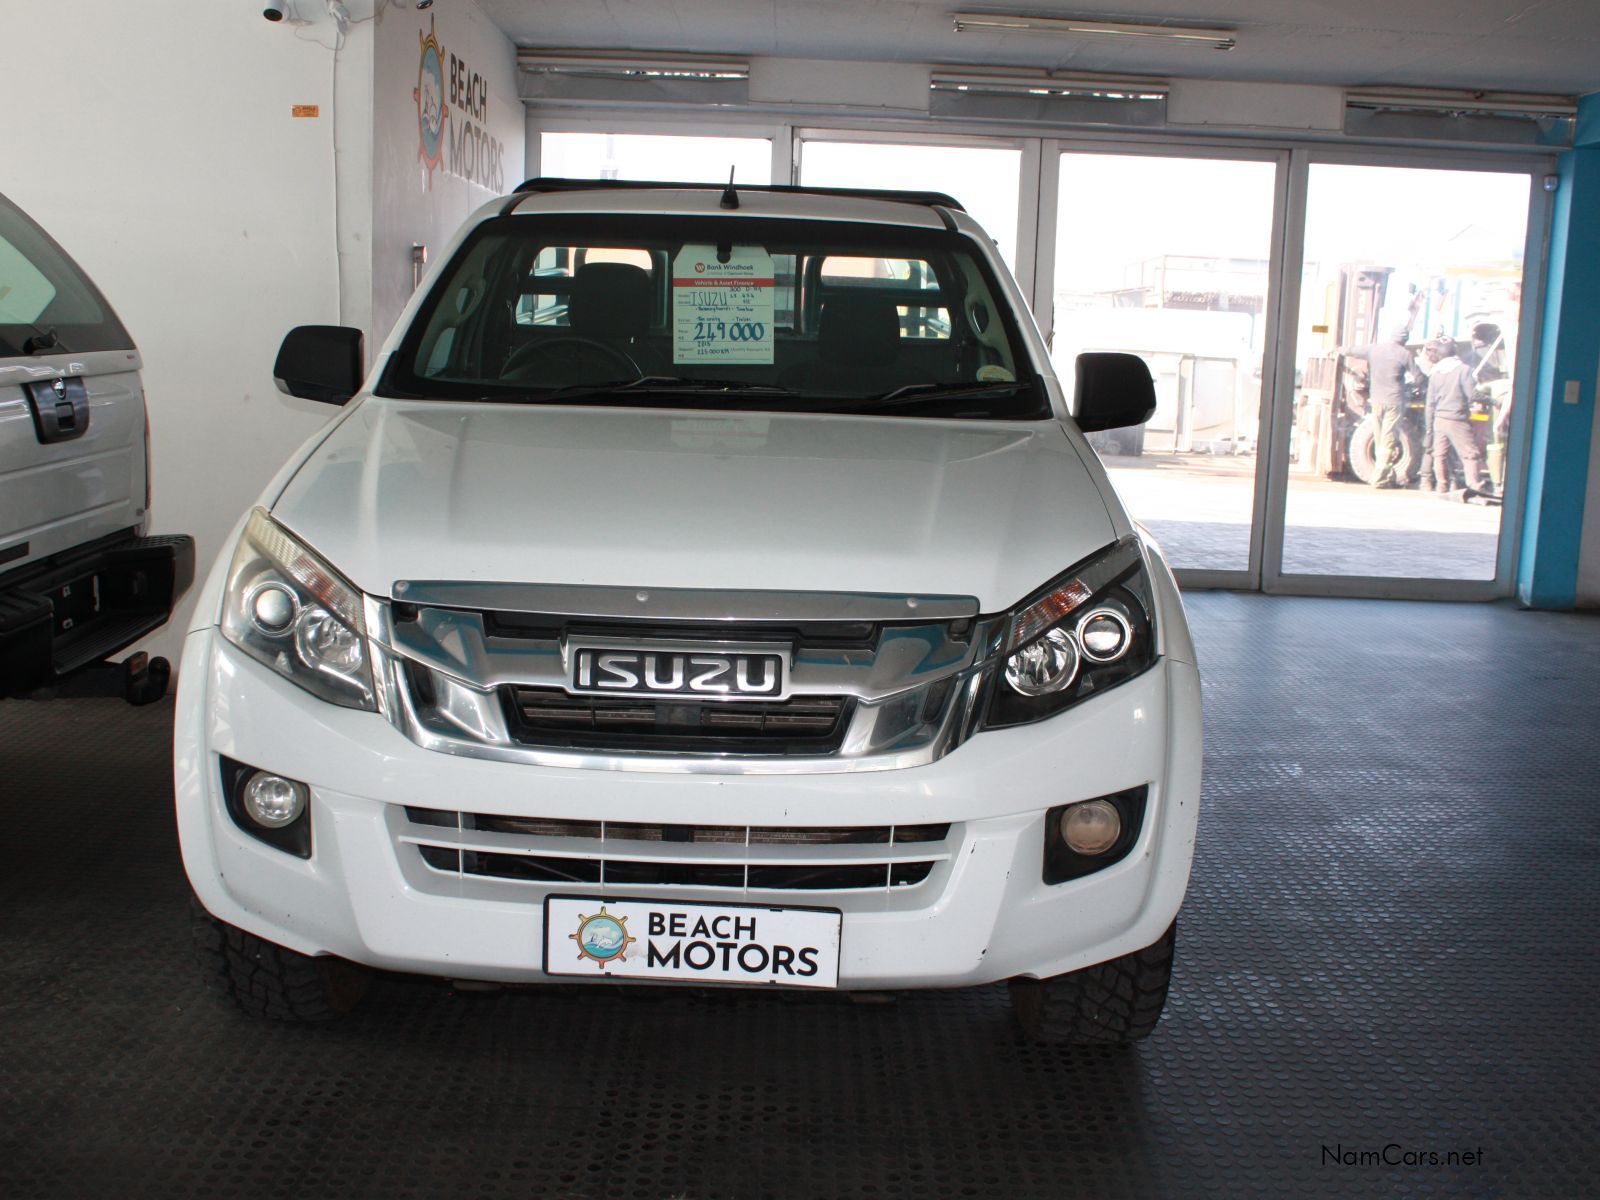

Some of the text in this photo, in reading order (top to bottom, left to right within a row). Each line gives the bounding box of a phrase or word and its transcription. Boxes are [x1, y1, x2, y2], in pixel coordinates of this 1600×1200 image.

[451, 53, 487, 124] BEACH
[450, 116, 504, 193] MOTORS
[689, 292, 728, 307] ISUZU
[693, 322, 765, 341] 249 000
[579, 652, 776, 692] ISUZU
[648, 912, 757, 941] BEACH
[647, 938, 819, 977] MOTORS
